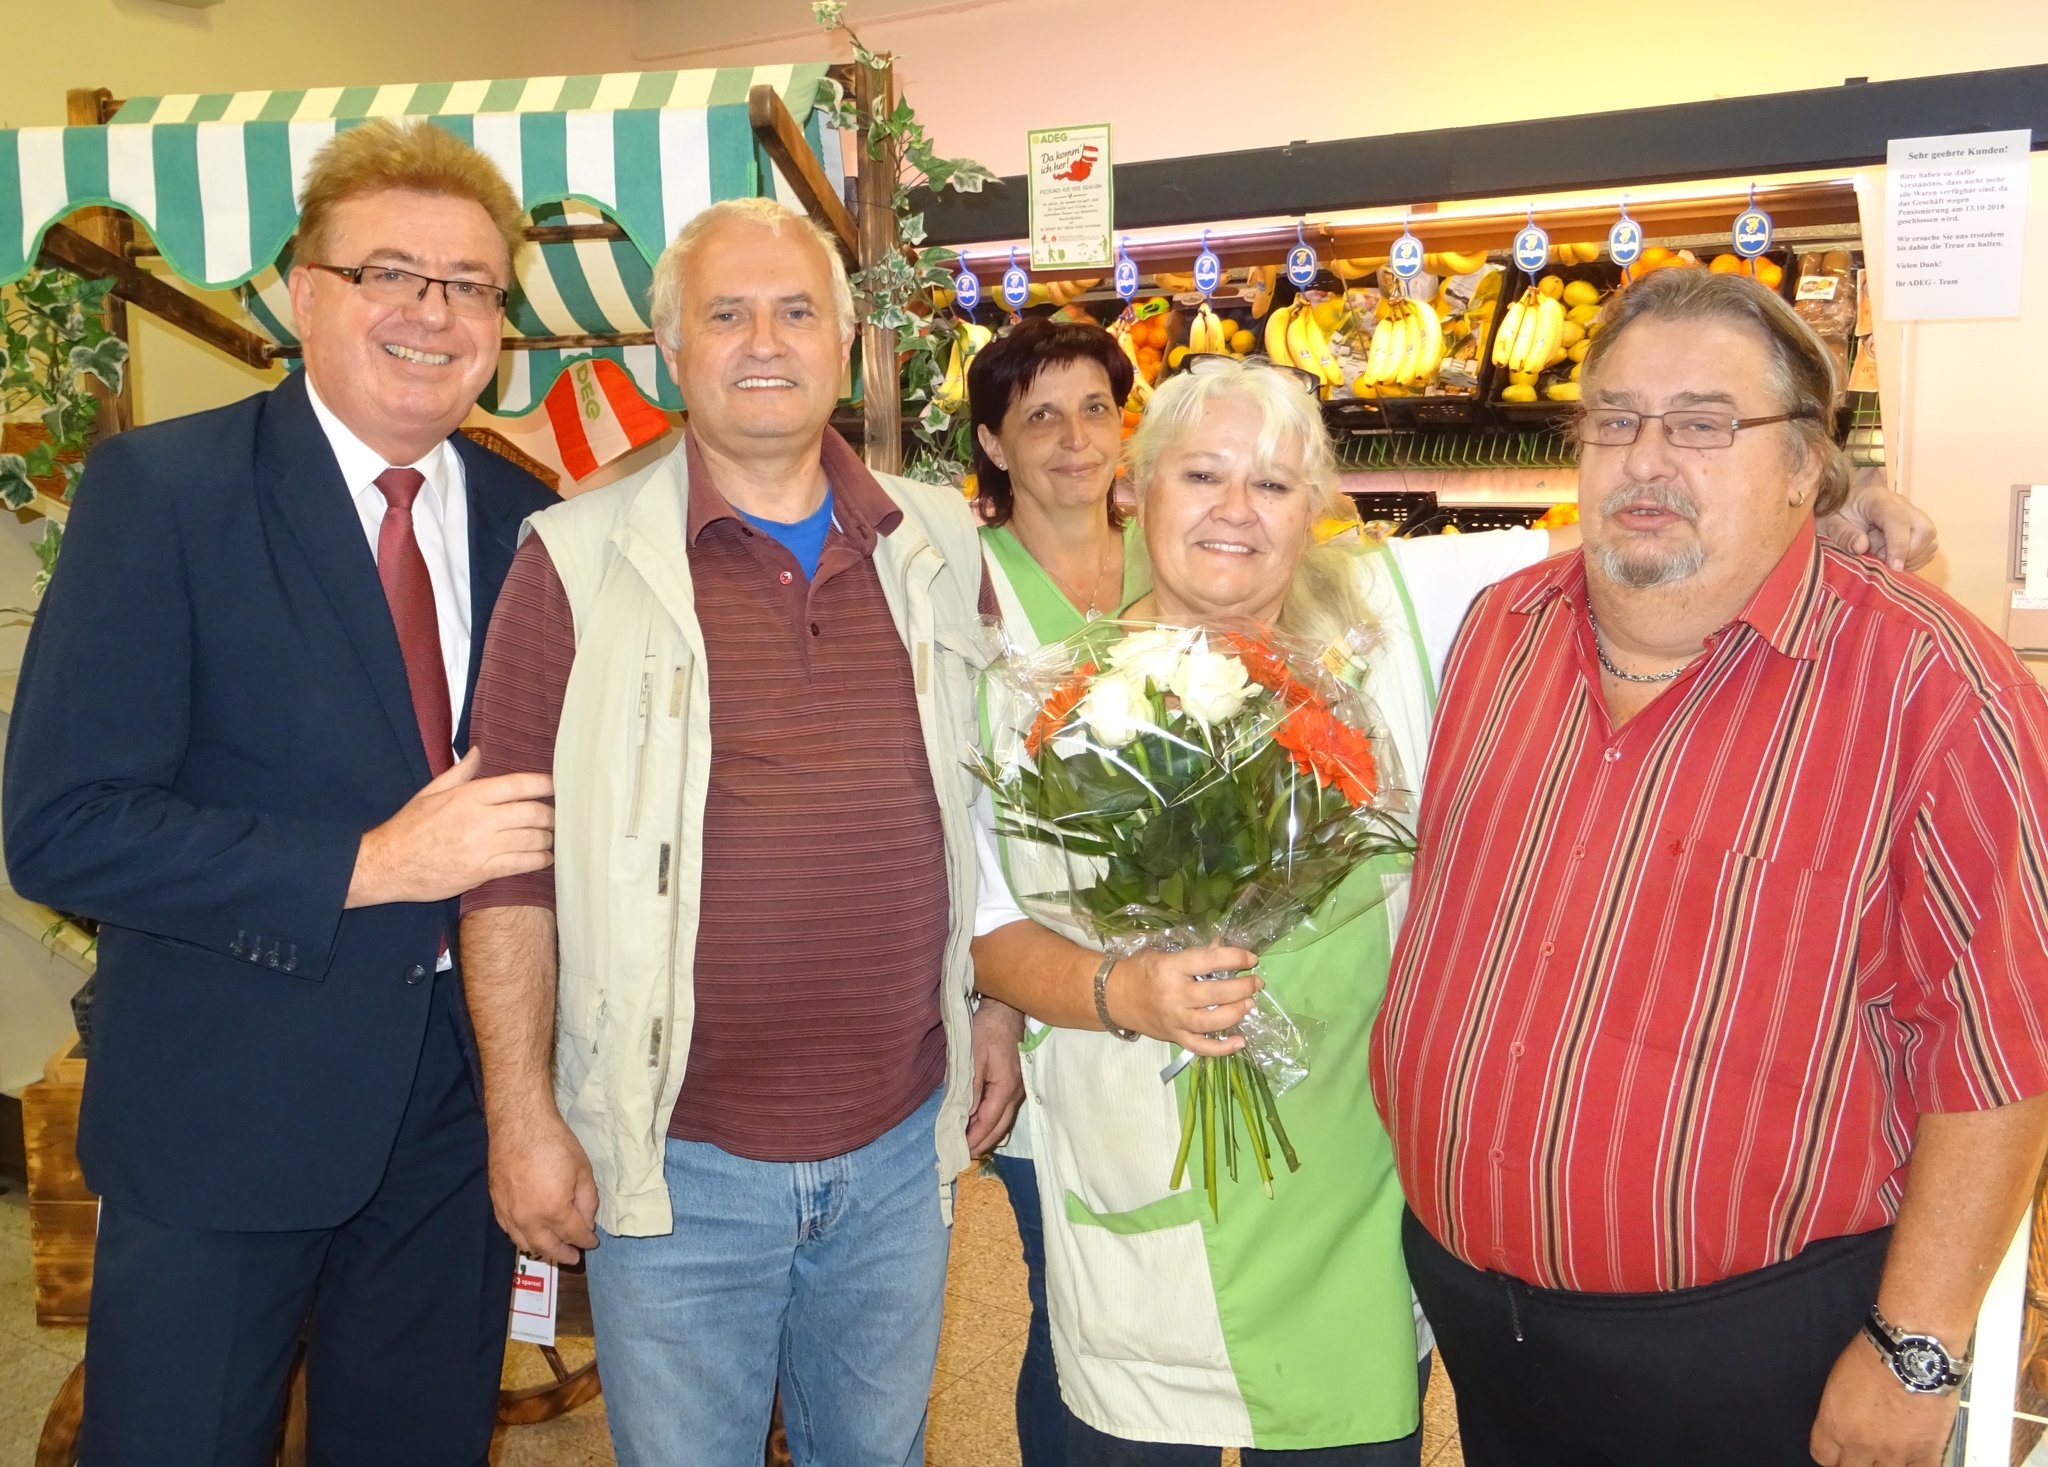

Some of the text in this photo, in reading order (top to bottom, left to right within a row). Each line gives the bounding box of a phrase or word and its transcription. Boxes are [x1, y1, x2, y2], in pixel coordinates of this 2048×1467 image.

[1040, 133, 1068, 143] ADEG
[1041, 153, 1054, 163] Da
[1908, 146, 2009, 160] Sehr geehrte Kunden!
[1041, 158, 1069, 174] ich her!
[1899, 190, 1911, 198] alle
[1913, 188, 1937, 196] Waren
[1939, 187, 1977, 196] verfügbar
[1998, 184, 2008, 192] da
[1912, 198, 1945, 206] Geschäft
[1898, 207, 1949, 216] Pensionierung
[1987, 203, 2005, 211] 2018
[1897, 216, 1938, 226] geschlossen
[1955, 232, 1968, 240] uns
[1970, 231, 2005, 239] trotzdem
[1908, 243, 1929, 251] dahin
[1931, 242, 1942, 250] die
[1919, 260, 1942, 268] Dank!
[1895, 280, 1906, 288] Ihr
[1907, 279, 1932, 287] ADEG
[1939, 278, 1959, 286] Team
